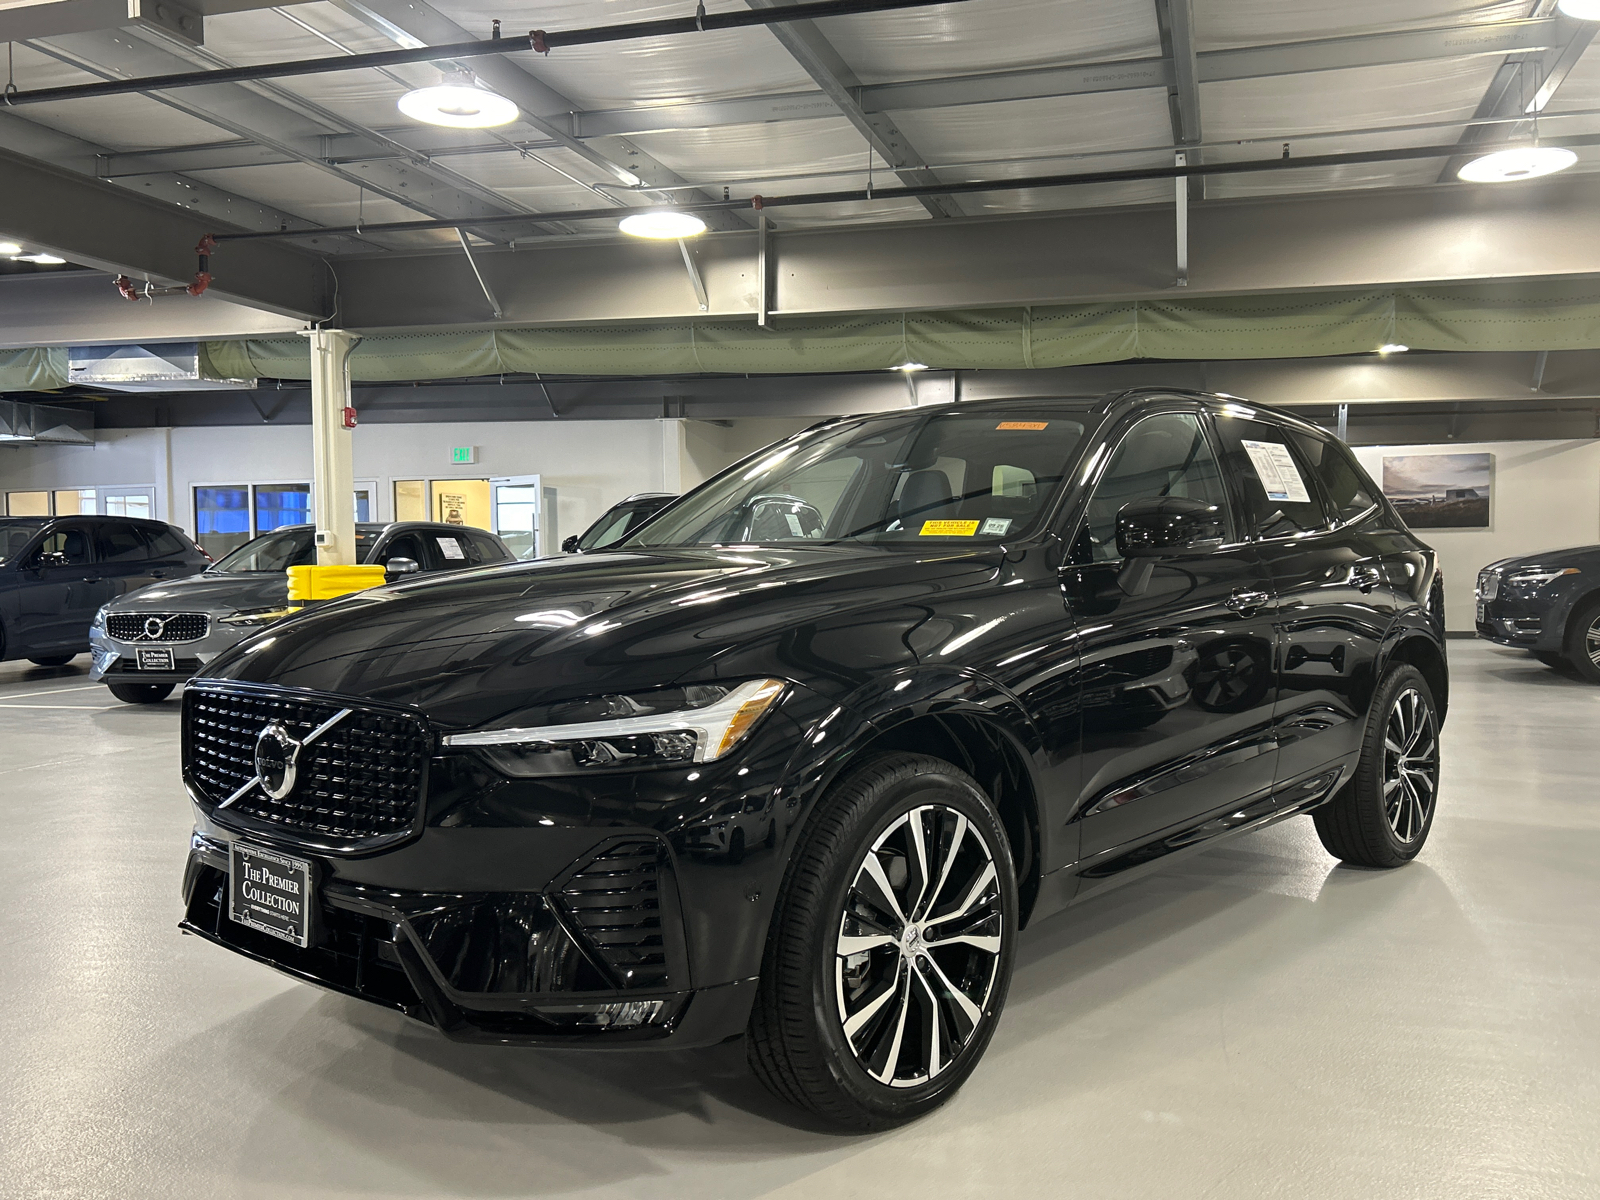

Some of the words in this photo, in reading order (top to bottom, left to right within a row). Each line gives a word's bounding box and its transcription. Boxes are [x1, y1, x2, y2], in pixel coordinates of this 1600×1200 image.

[453, 447, 470, 462] EXIT
[242, 861, 262, 883] THE
[261, 867, 300, 895] PREMIER
[242, 880, 300, 916] COLLECTION
